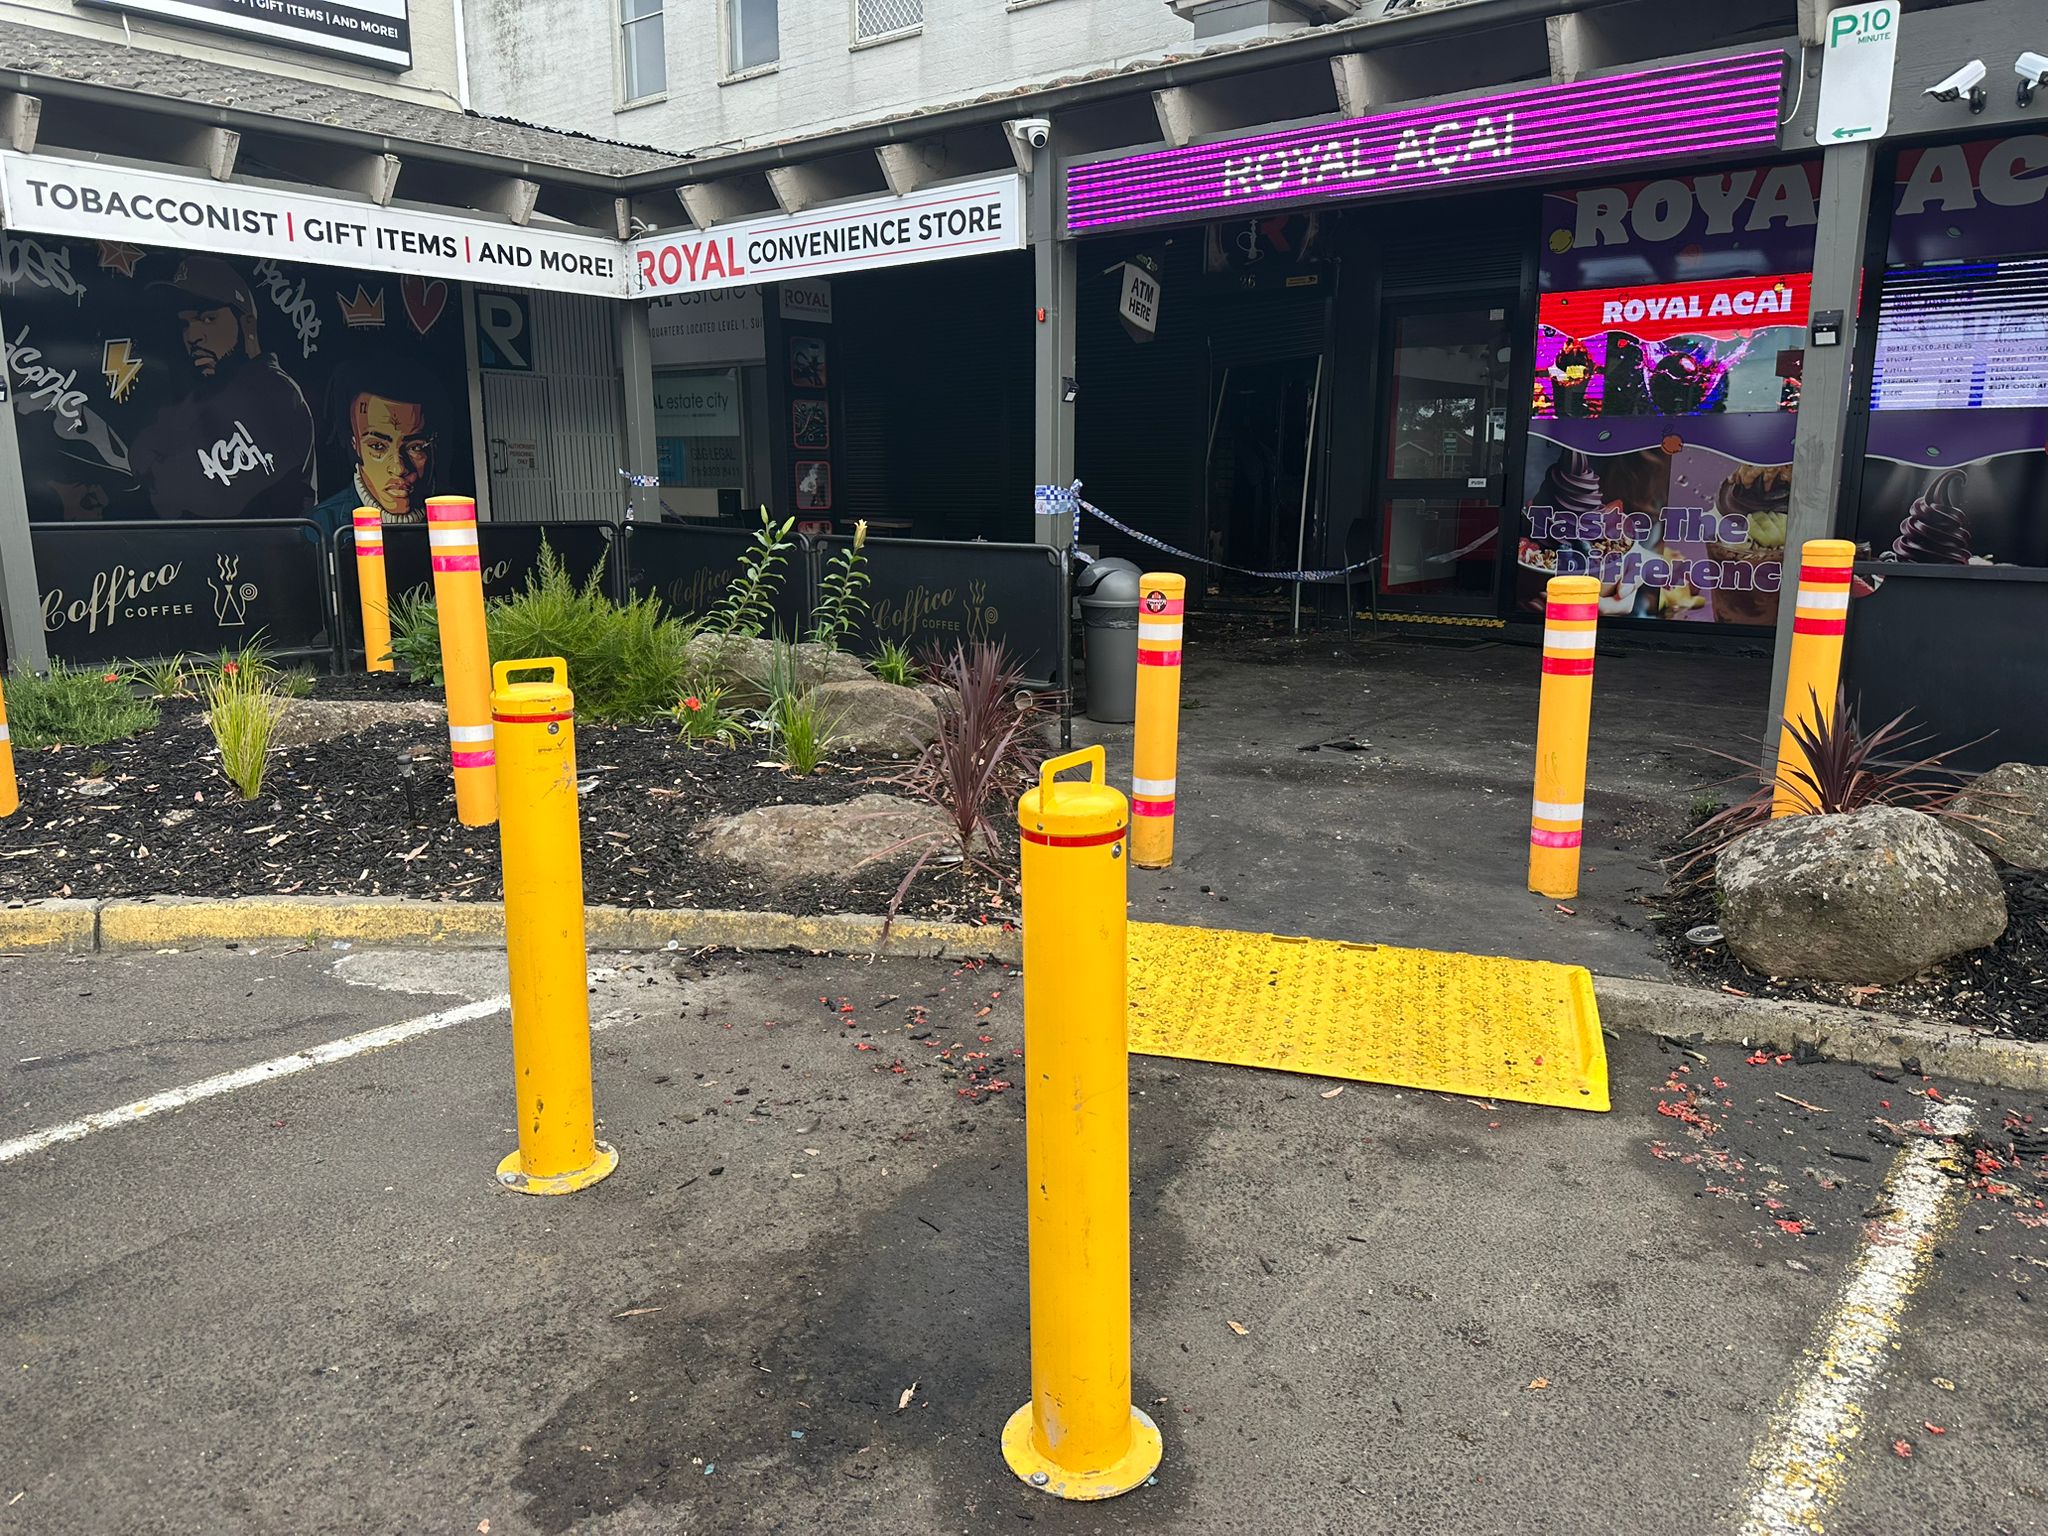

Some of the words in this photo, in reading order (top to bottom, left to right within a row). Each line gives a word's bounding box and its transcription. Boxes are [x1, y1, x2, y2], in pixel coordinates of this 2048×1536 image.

[286, 4, 324, 22] ITEMS
[332, 14, 358, 30] AND
[360, 21, 399, 39] MORE!
[1857, 32, 1892, 44] MINUTE
[1224, 138, 1377, 197] ROYAL
[1573, 163, 1821, 249] ROYA
[26, 179, 279, 237] TOBACCONIST
[303, 217, 367, 248] GIFT
[375, 226, 458, 259] ITEMS
[478, 243, 532, 269] AND
[540, 249, 614, 278] MORE!
[636, 237, 745, 287] ROYAL
[748, 217, 911, 265] CONVENIENCE
[918, 203, 1002, 241] STORE
[784, 289, 830, 308] ROYAL
[1131, 277, 1154, 304] ATM
[1128, 297, 1152, 322] HERE
[1602, 295, 1703, 324] ROYAL
[650, 325, 684, 338] QUARTERS
[686, 321, 716, 334] LOCATED
[718, 318, 740, 332] LEVEL
[666, 394, 704, 409] estate
[707, 392, 729, 411] city
[1527, 505, 1652, 542] Taste
[1659, 506, 1749, 544] The
[1556, 549, 1783, 591] Differenc
[125, 604, 194, 618] COFFEE
[872, 584, 957, 636] Coffico
[921, 618, 961, 632] COFFEE
